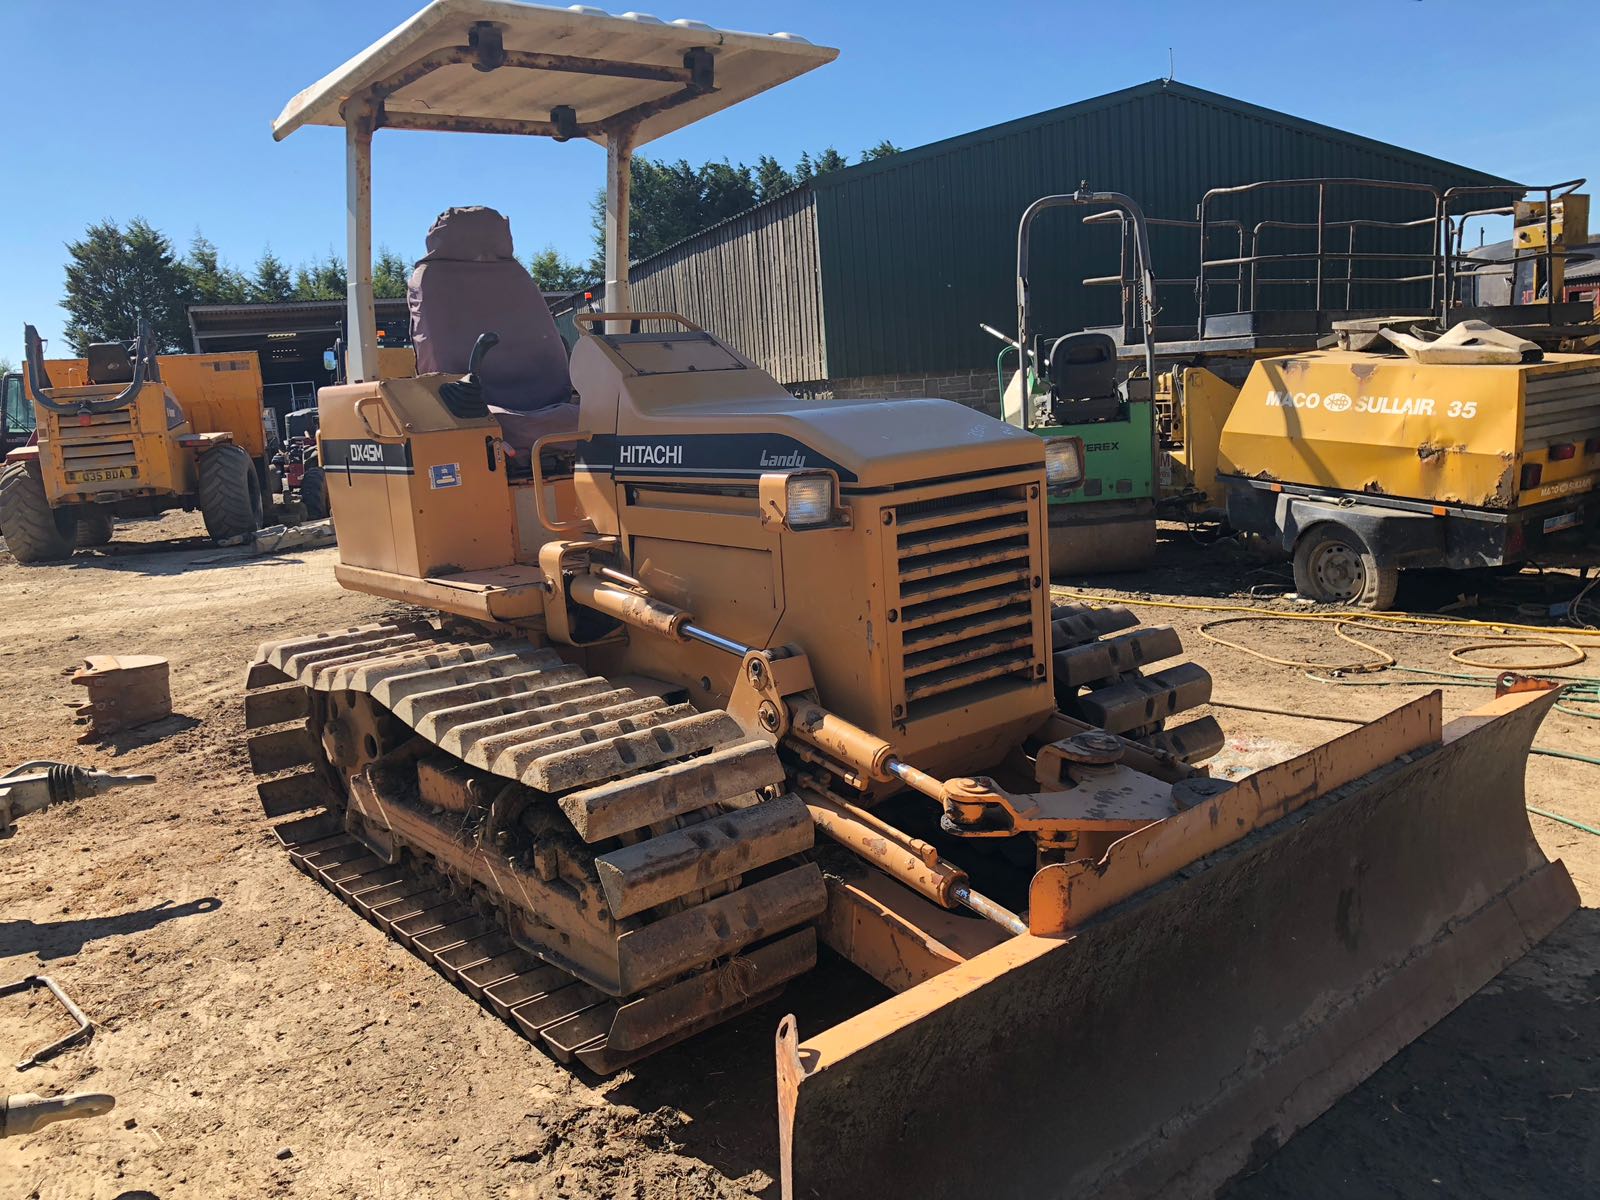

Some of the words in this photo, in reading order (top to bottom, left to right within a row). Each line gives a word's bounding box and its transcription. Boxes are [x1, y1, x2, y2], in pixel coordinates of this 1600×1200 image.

[1265, 390, 1321, 409] MACO
[1355, 396, 1436, 416] SULLAIR
[1447, 400, 1478, 419] 35
[350, 444, 384, 462] DX45M
[620, 445, 683, 464] HITACHI
[1084, 441, 1120, 452] EREX
[760, 449, 806, 468] Landy
